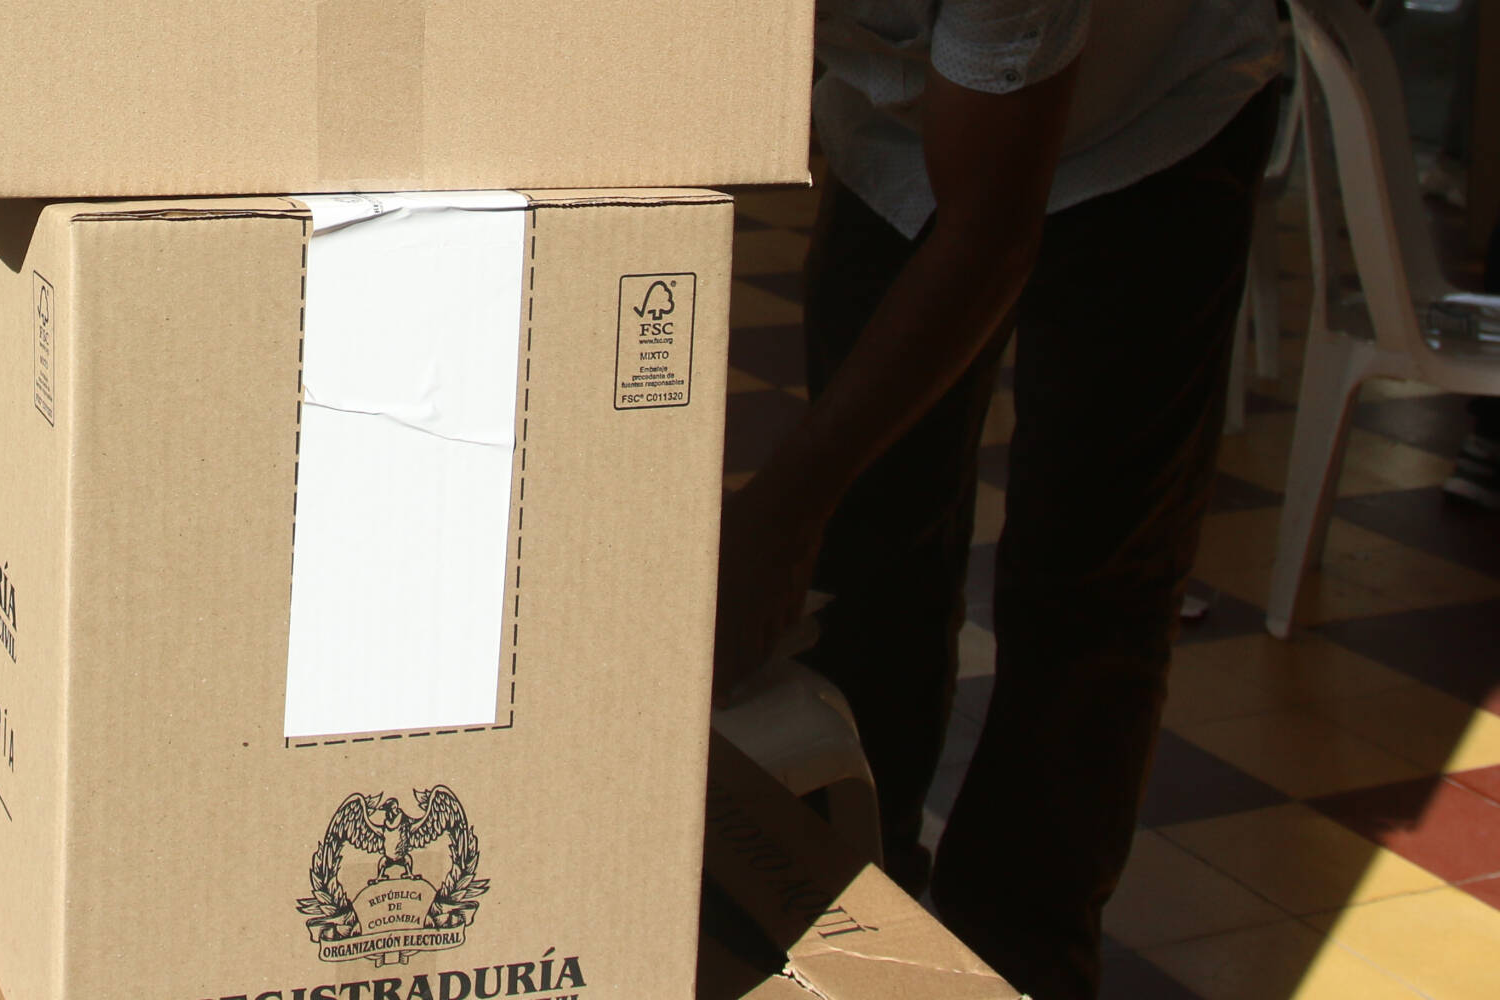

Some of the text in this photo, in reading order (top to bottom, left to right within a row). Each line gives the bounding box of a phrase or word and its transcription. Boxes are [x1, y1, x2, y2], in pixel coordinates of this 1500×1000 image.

[639, 322, 674, 337] FSC
[640, 350, 669, 361] MIXTO
[646, 391, 684, 402] C011320
[368, 890, 423, 908] REPÚBLICA
[388, 903, 403, 912] DE
[367, 914, 421, 930] COLOMBIA
[323, 930, 462, 959] ORGANIZACIÓN ELECTORAL
